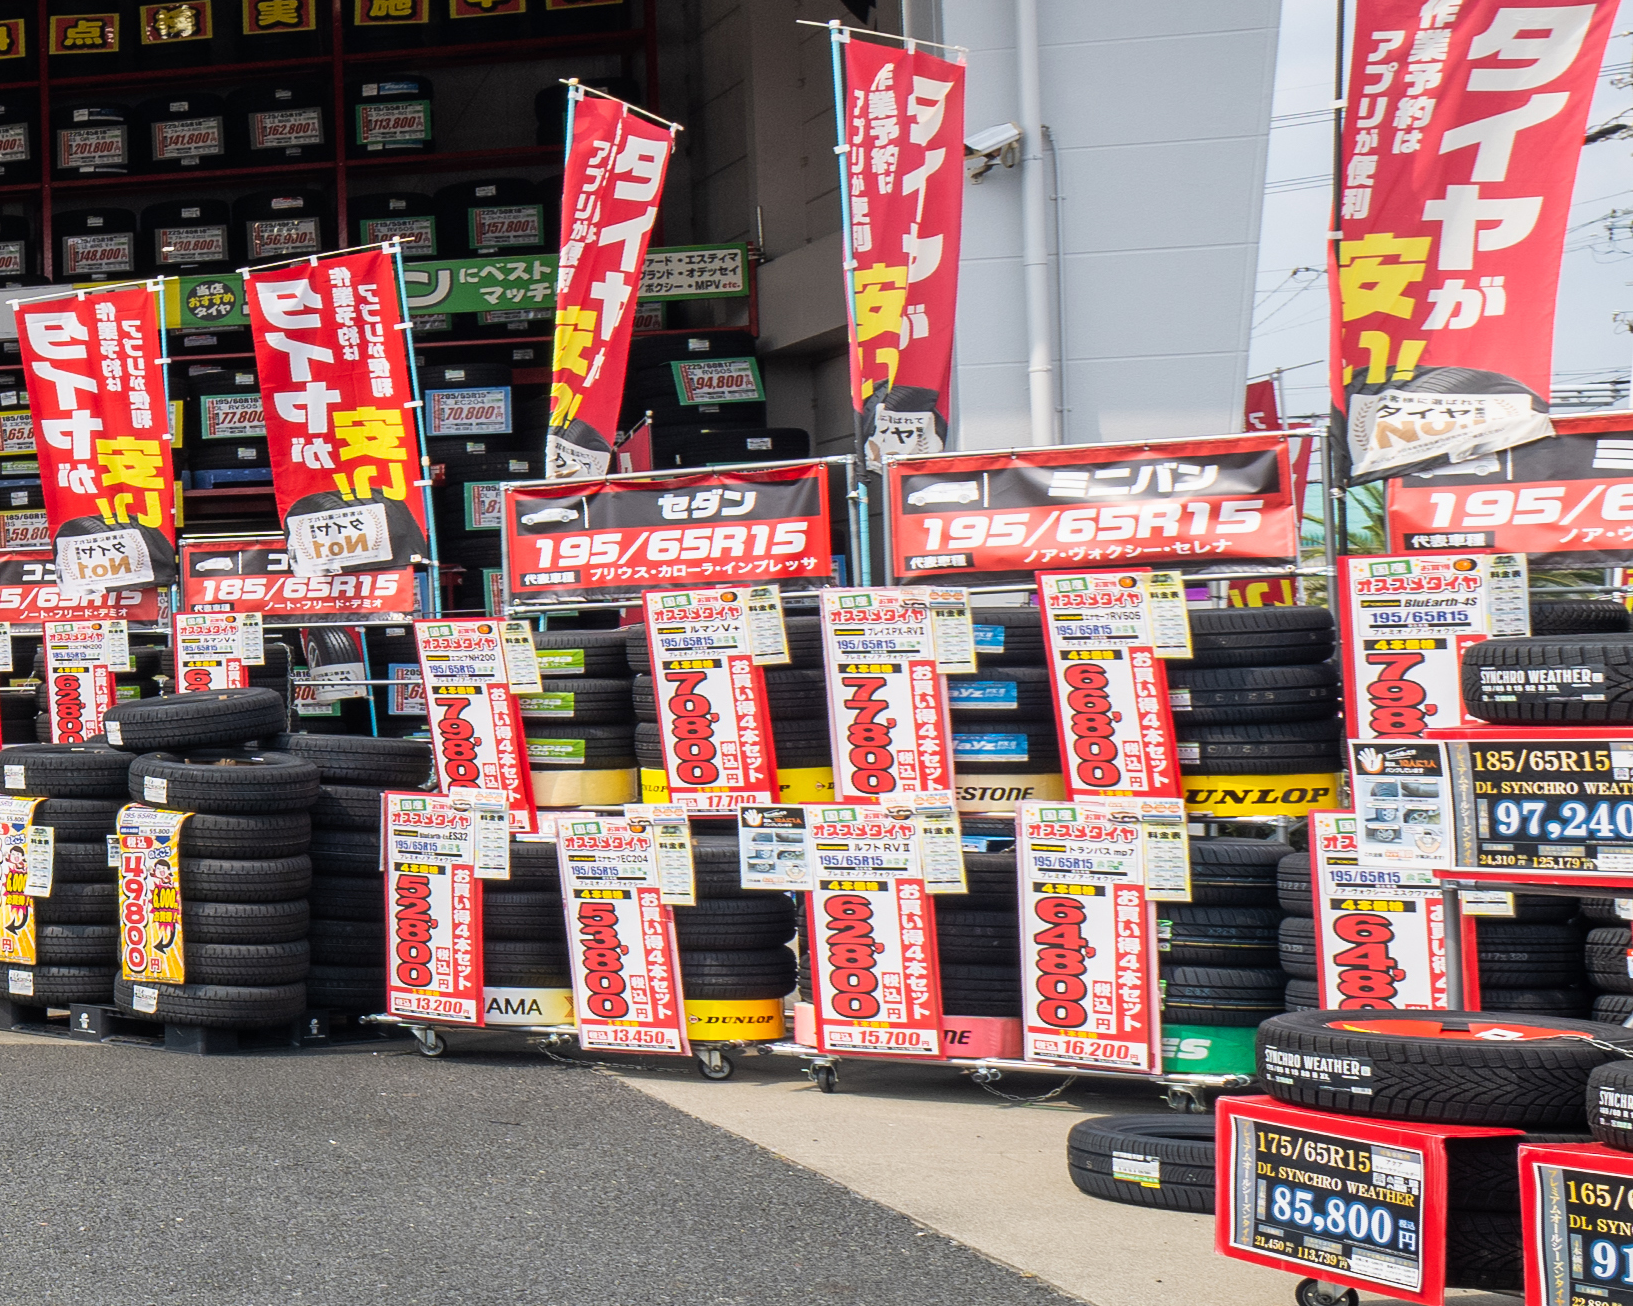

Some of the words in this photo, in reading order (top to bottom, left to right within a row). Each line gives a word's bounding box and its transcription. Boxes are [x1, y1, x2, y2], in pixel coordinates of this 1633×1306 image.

[257, 0, 300, 26] 実
[1342, 30, 1404, 220] アプリが便利
[1421, 4, 1597, 331] タイヤが
[685, 252, 741, 265] エスティマ
[460, 261, 553, 284] にベスト
[685, 265, 741, 278] オデッセイ
[694, 279, 721, 292] MPV
[188, 294, 234, 306] おすすめ
[1049, 461, 1219, 496] ミニバン
[657, 491, 757, 521] セダン
[922, 499, 1265, 549] 195/65R15
[534, 521, 808, 569] 195/65R15
[1023, 539, 1233, 563] ノア・ヴォクシー・セレナ
[1412, 532, 1487, 548] 代表車種
[590, 557, 818, 579] プリウス・カローラ・インプレッサ
[203, 573, 400, 600] 185/65R15
[20, 608, 128, 618] ノート・フリード・デミオ
[265, 598, 383, 609] ノート・フリード・デミオ
[653, 606, 742, 623] オススメタイヤ
[1369, 607, 1469, 626] 195/65R15
[1480, 670, 1525, 684] SYNCHRO
[1528, 668, 1591, 683] WEATHER
[731, 659, 763, 783] お買い得4本セット
[1473, 749, 1610, 773] 185/65R15
[1475, 782, 1497, 794] DL
[1501, 781, 1578, 795] SYNCHRO
[812, 822, 915, 840] オススメタイヤ
[818, 853, 883, 869] 195/65R15
[1479, 855, 1515, 866] 24,310
[1533, 856, 1580, 870] 125,179
[900, 883, 929, 1019] お買い得4本セット
[705, 1012, 774, 1025] DUNLOP
[1264, 1049, 1300, 1069] SYNCHRO
[1303, 1055, 1361, 1077] WEATHER
[1257, 1131, 1370, 1173] 175/65R15
[1257, 1161, 1275, 1177] DL
[1278, 1166, 1342, 1191] SYNCHRO
[1347, 1179, 1415, 1207] WEATHER
[1272, 1184, 1393, 1245] 85,800
